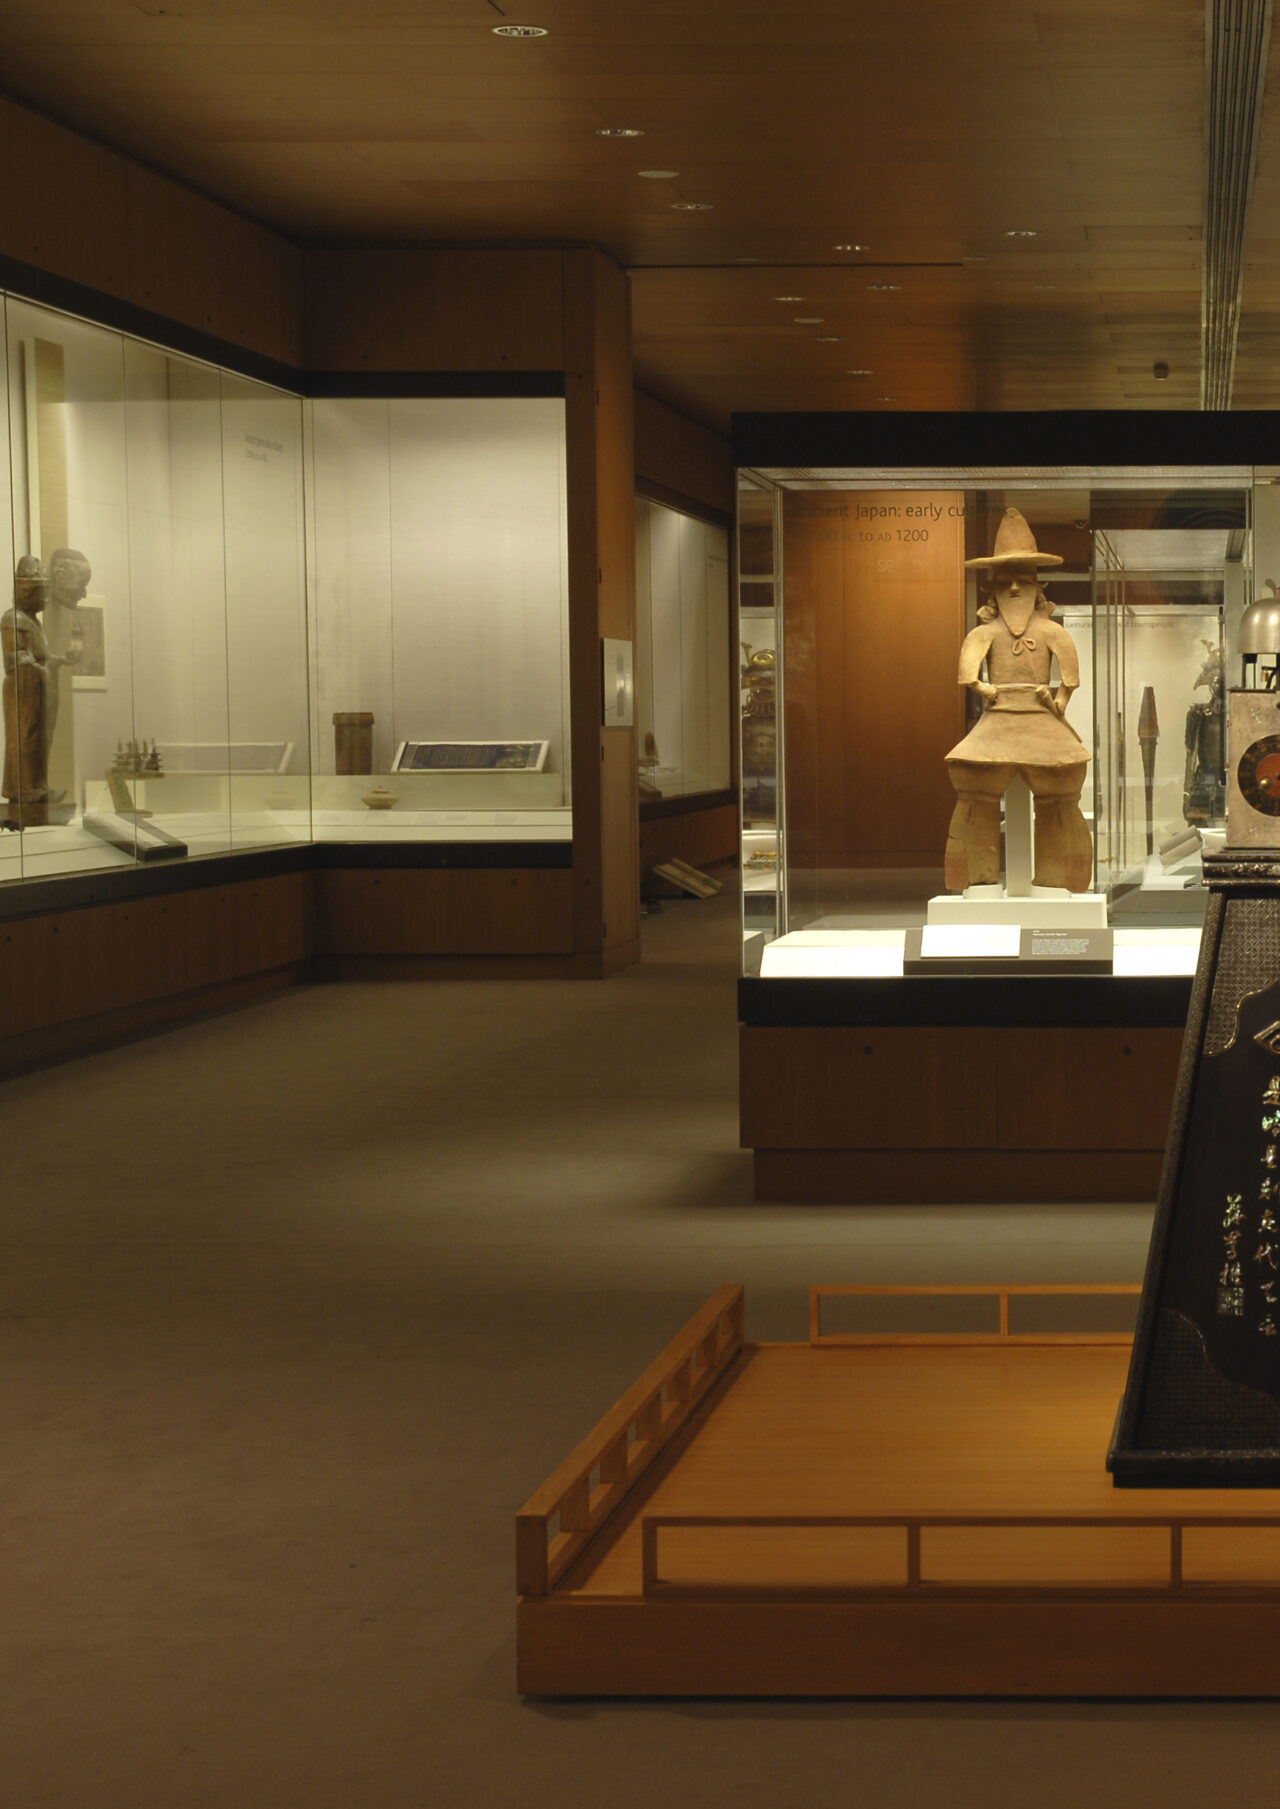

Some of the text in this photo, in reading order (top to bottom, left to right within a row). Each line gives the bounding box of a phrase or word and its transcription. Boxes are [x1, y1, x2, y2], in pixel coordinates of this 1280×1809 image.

[855, 503, 901, 521] Japan:
[906, 502, 942, 521] early
[860, 531, 873, 542] to
[878, 533, 892, 542] AD
[896, 529, 929, 542] 1200
